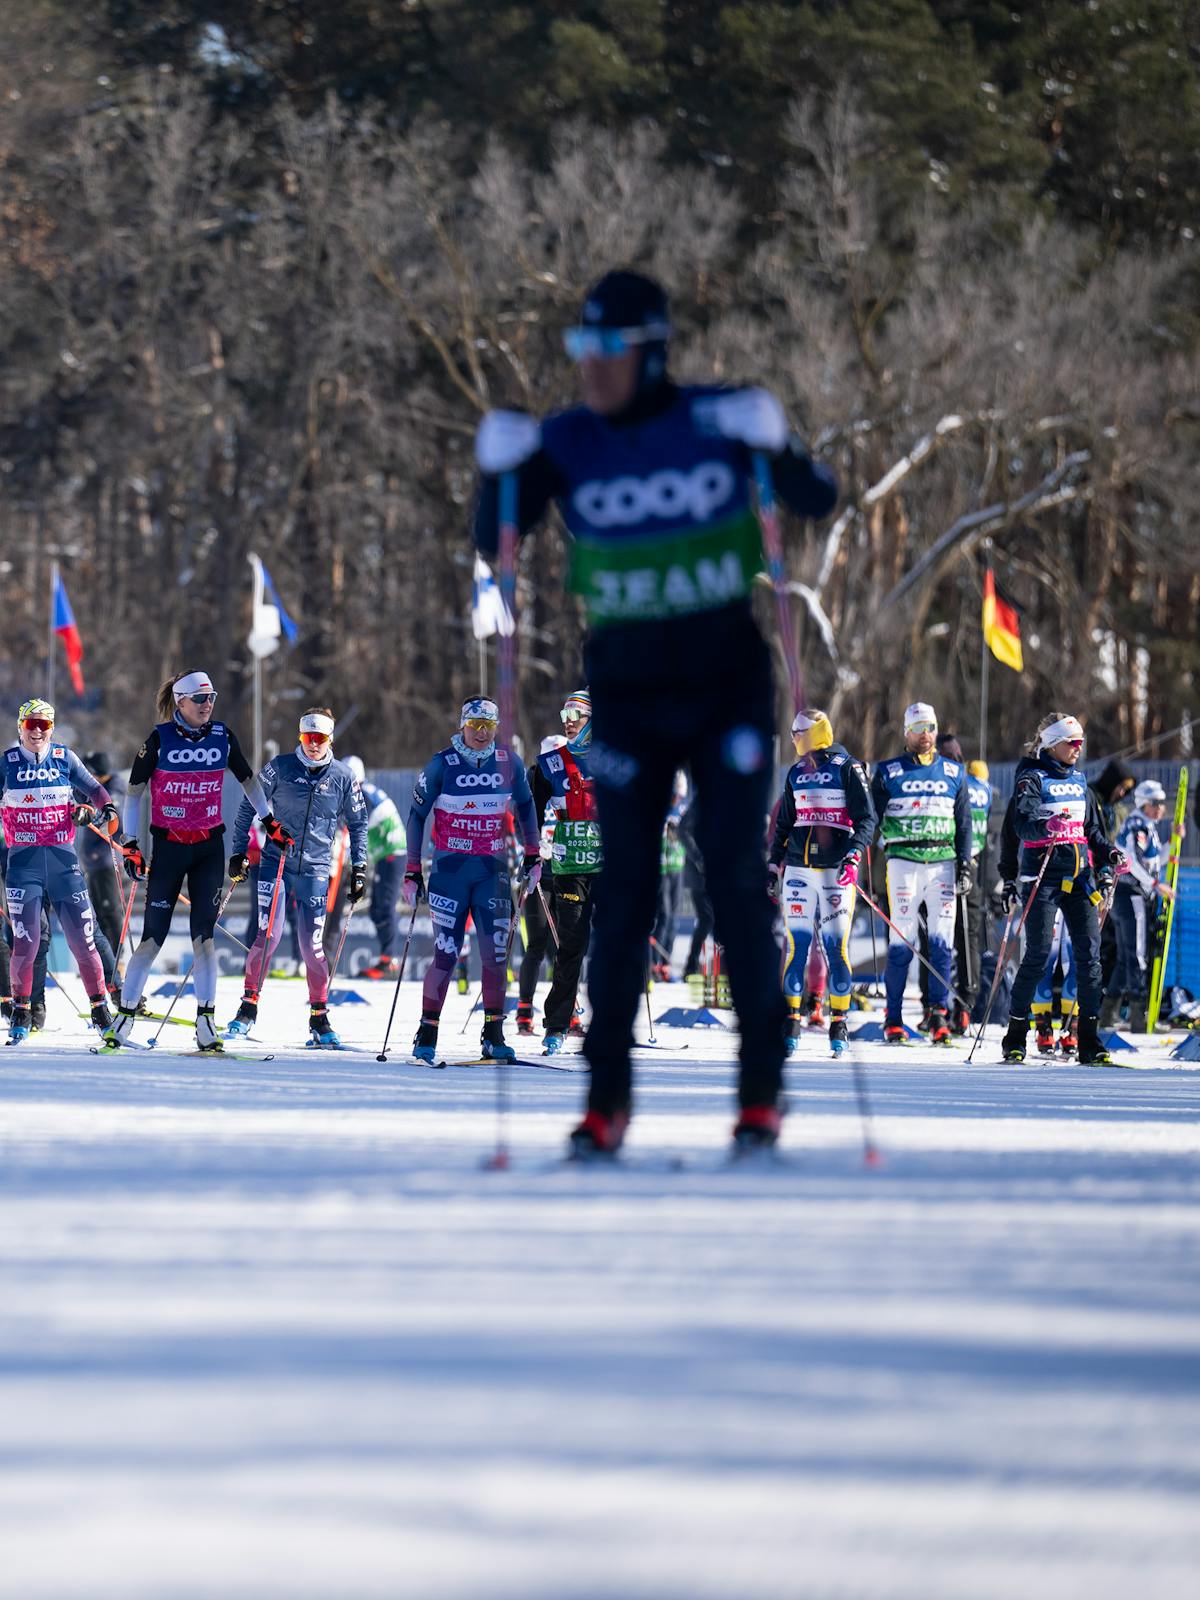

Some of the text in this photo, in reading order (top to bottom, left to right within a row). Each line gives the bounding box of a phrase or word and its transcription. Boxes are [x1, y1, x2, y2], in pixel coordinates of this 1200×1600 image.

[572, 461, 736, 527] coop
[593, 553, 744, 606] TEAM
[167, 748, 221, 765] coop
[17, 768, 60, 782] coop
[456, 773, 504, 788] coop
[796, 772, 833, 784] coop
[163, 780, 221, 794] ATHLETE
[901, 780, 948, 794] coop
[1049, 783, 1084, 797] coop
[17, 810, 65, 824] ATHLETE
[899, 819, 950, 834] TEAM
[430, 895, 456, 911] VISA
